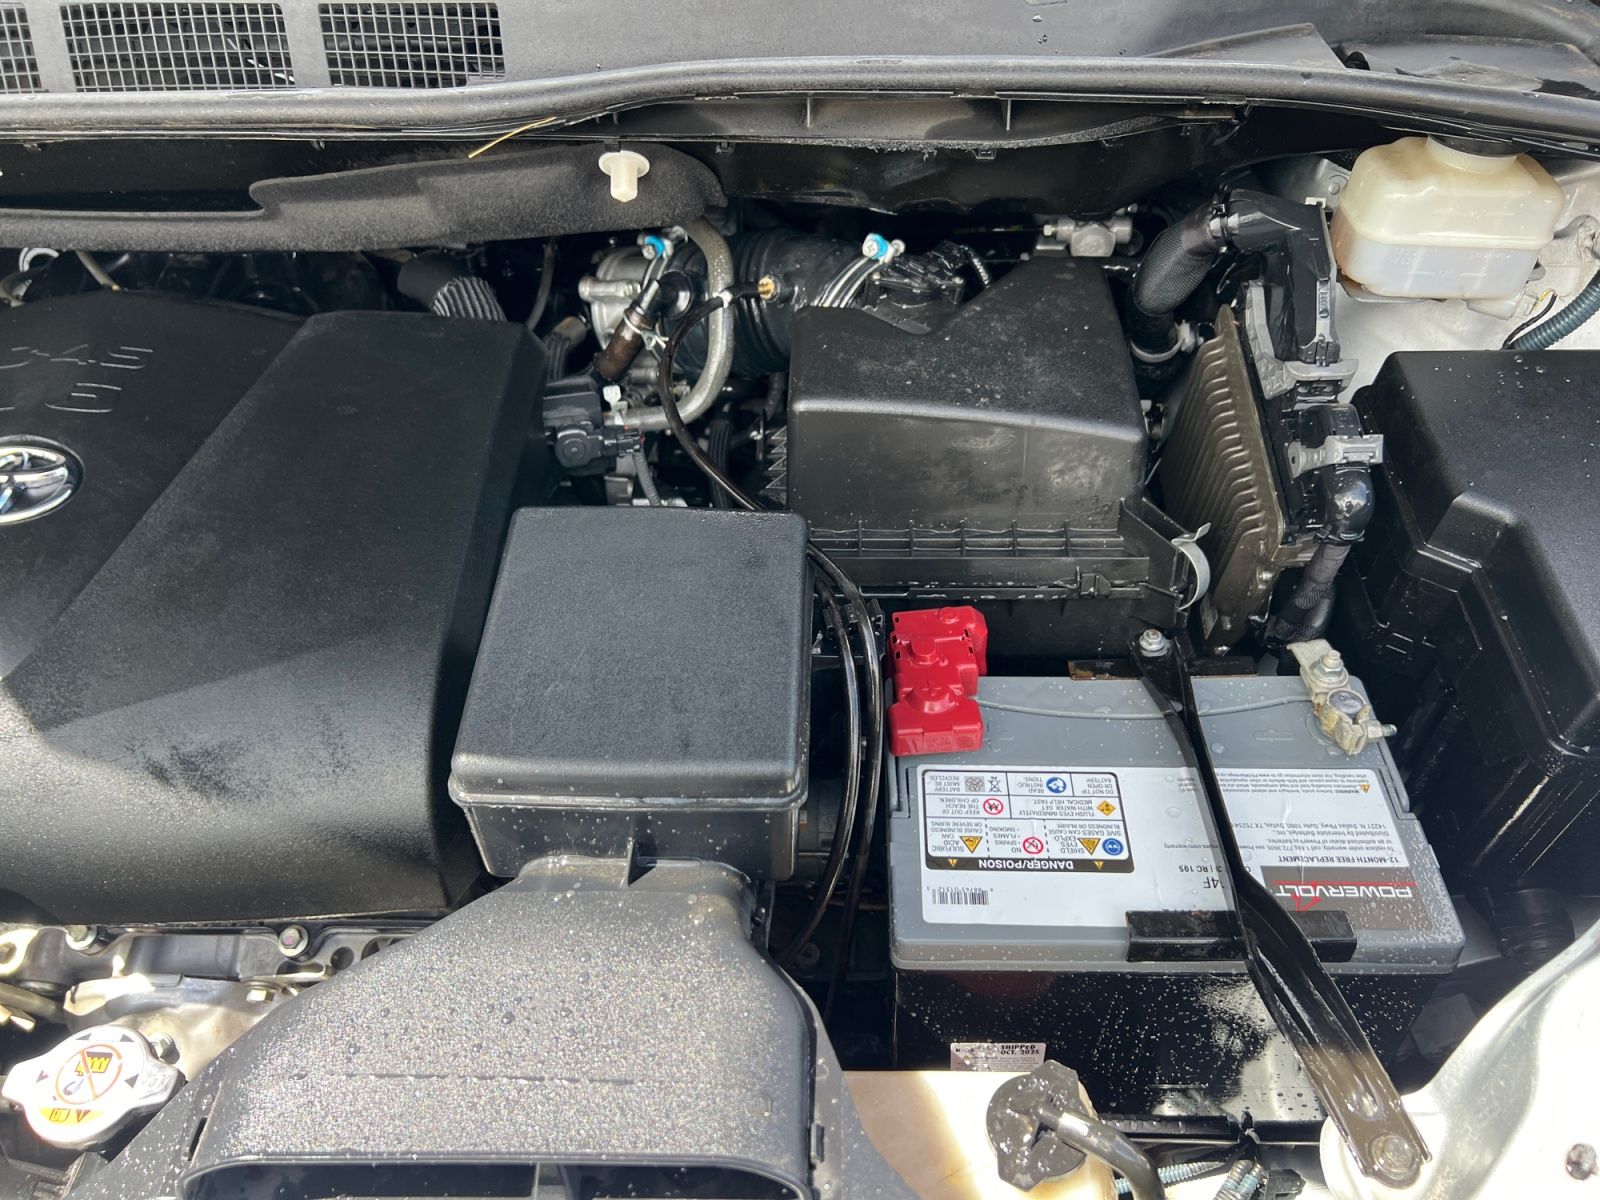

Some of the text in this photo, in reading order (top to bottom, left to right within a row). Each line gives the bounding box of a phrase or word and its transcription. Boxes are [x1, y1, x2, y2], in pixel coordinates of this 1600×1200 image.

[978, 859, 1074, 869] DANGER/POISON
[1203, 877, 1224, 888] 4F
[1275, 885, 1412, 898] POWERVOLT
